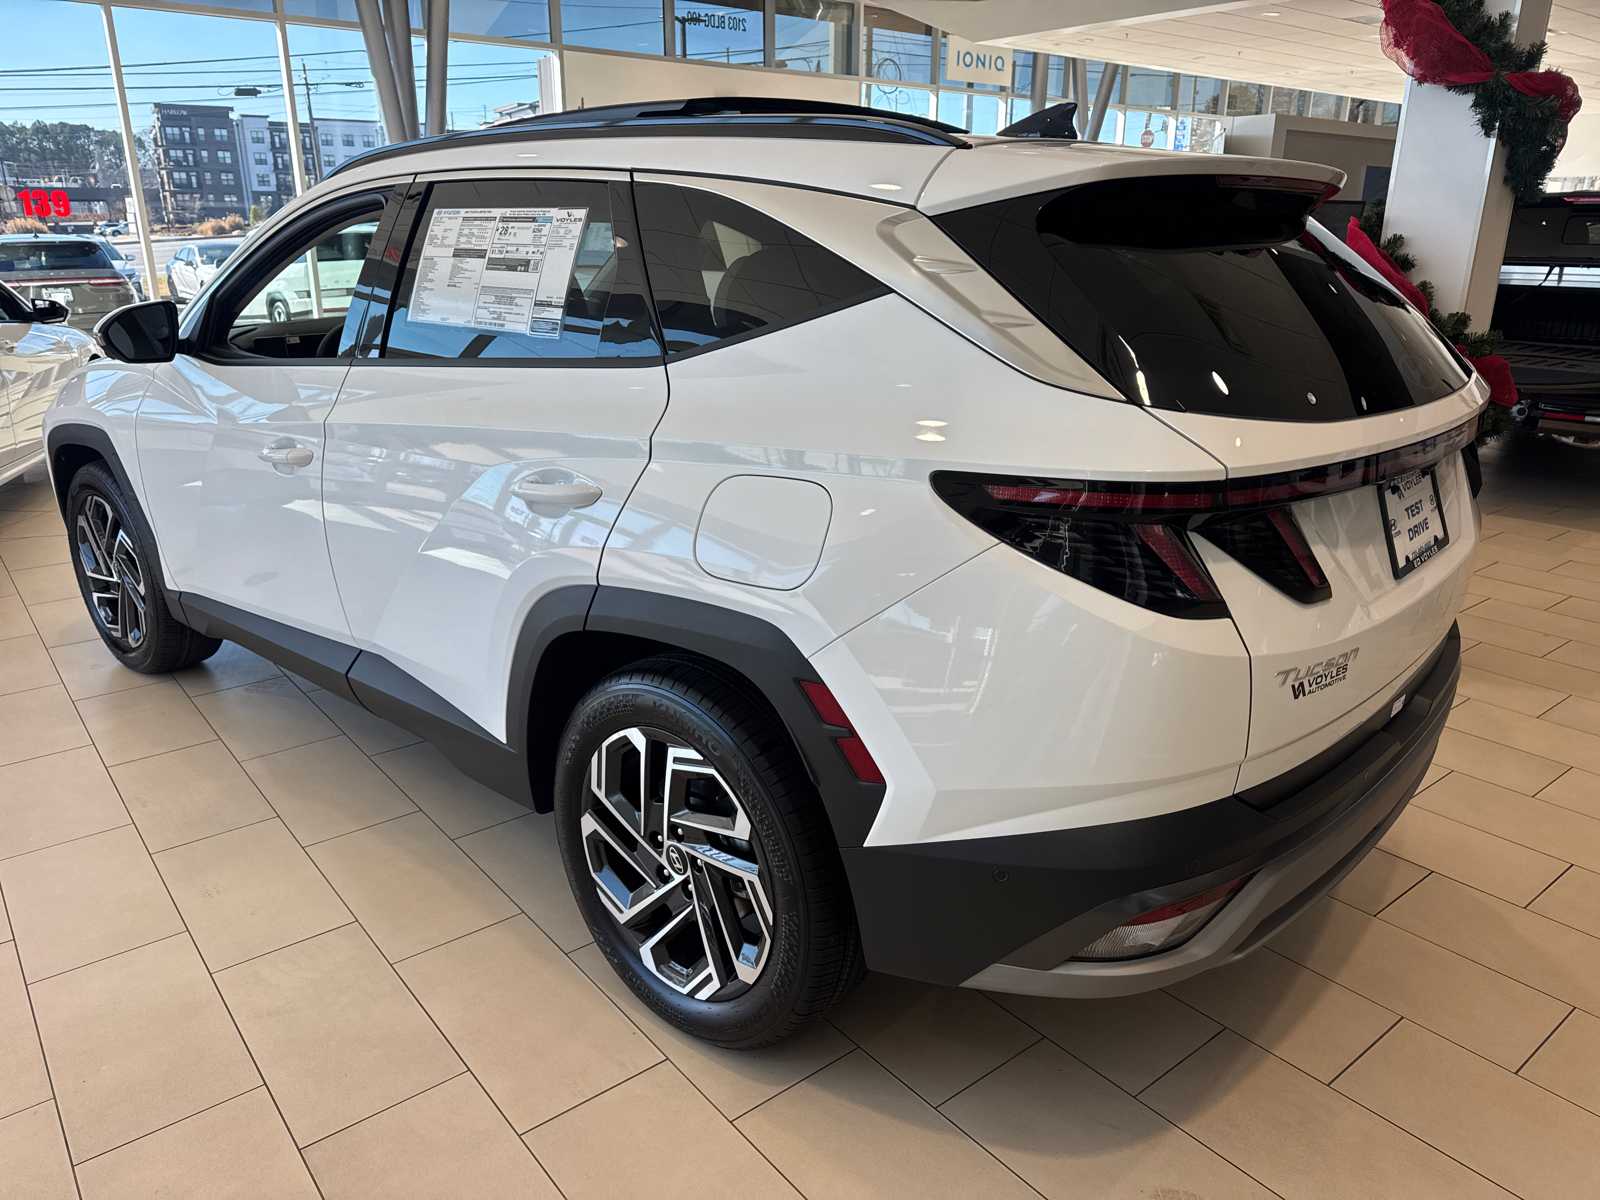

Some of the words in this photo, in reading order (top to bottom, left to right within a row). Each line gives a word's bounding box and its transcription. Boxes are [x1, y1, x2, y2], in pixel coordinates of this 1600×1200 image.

[956, 50, 1005, 72] IONIQ
[1141, 134, 1154, 143] STOP
[16, 189, 71, 217] 139
[499, 226, 509, 235] 28
[1401, 473, 1422, 492] VOYLES
[1404, 499, 1424, 520] TEST
[1407, 517, 1430, 542] DRIVE
[1421, 545, 1438, 562] VOYLES
[1274, 647, 1360, 688] TUCSON
[1307, 663, 1349, 688] VOYLES
[1307, 674, 1347, 696] AUTOMOTIVE
[652, 700, 721, 757] KUMHO
